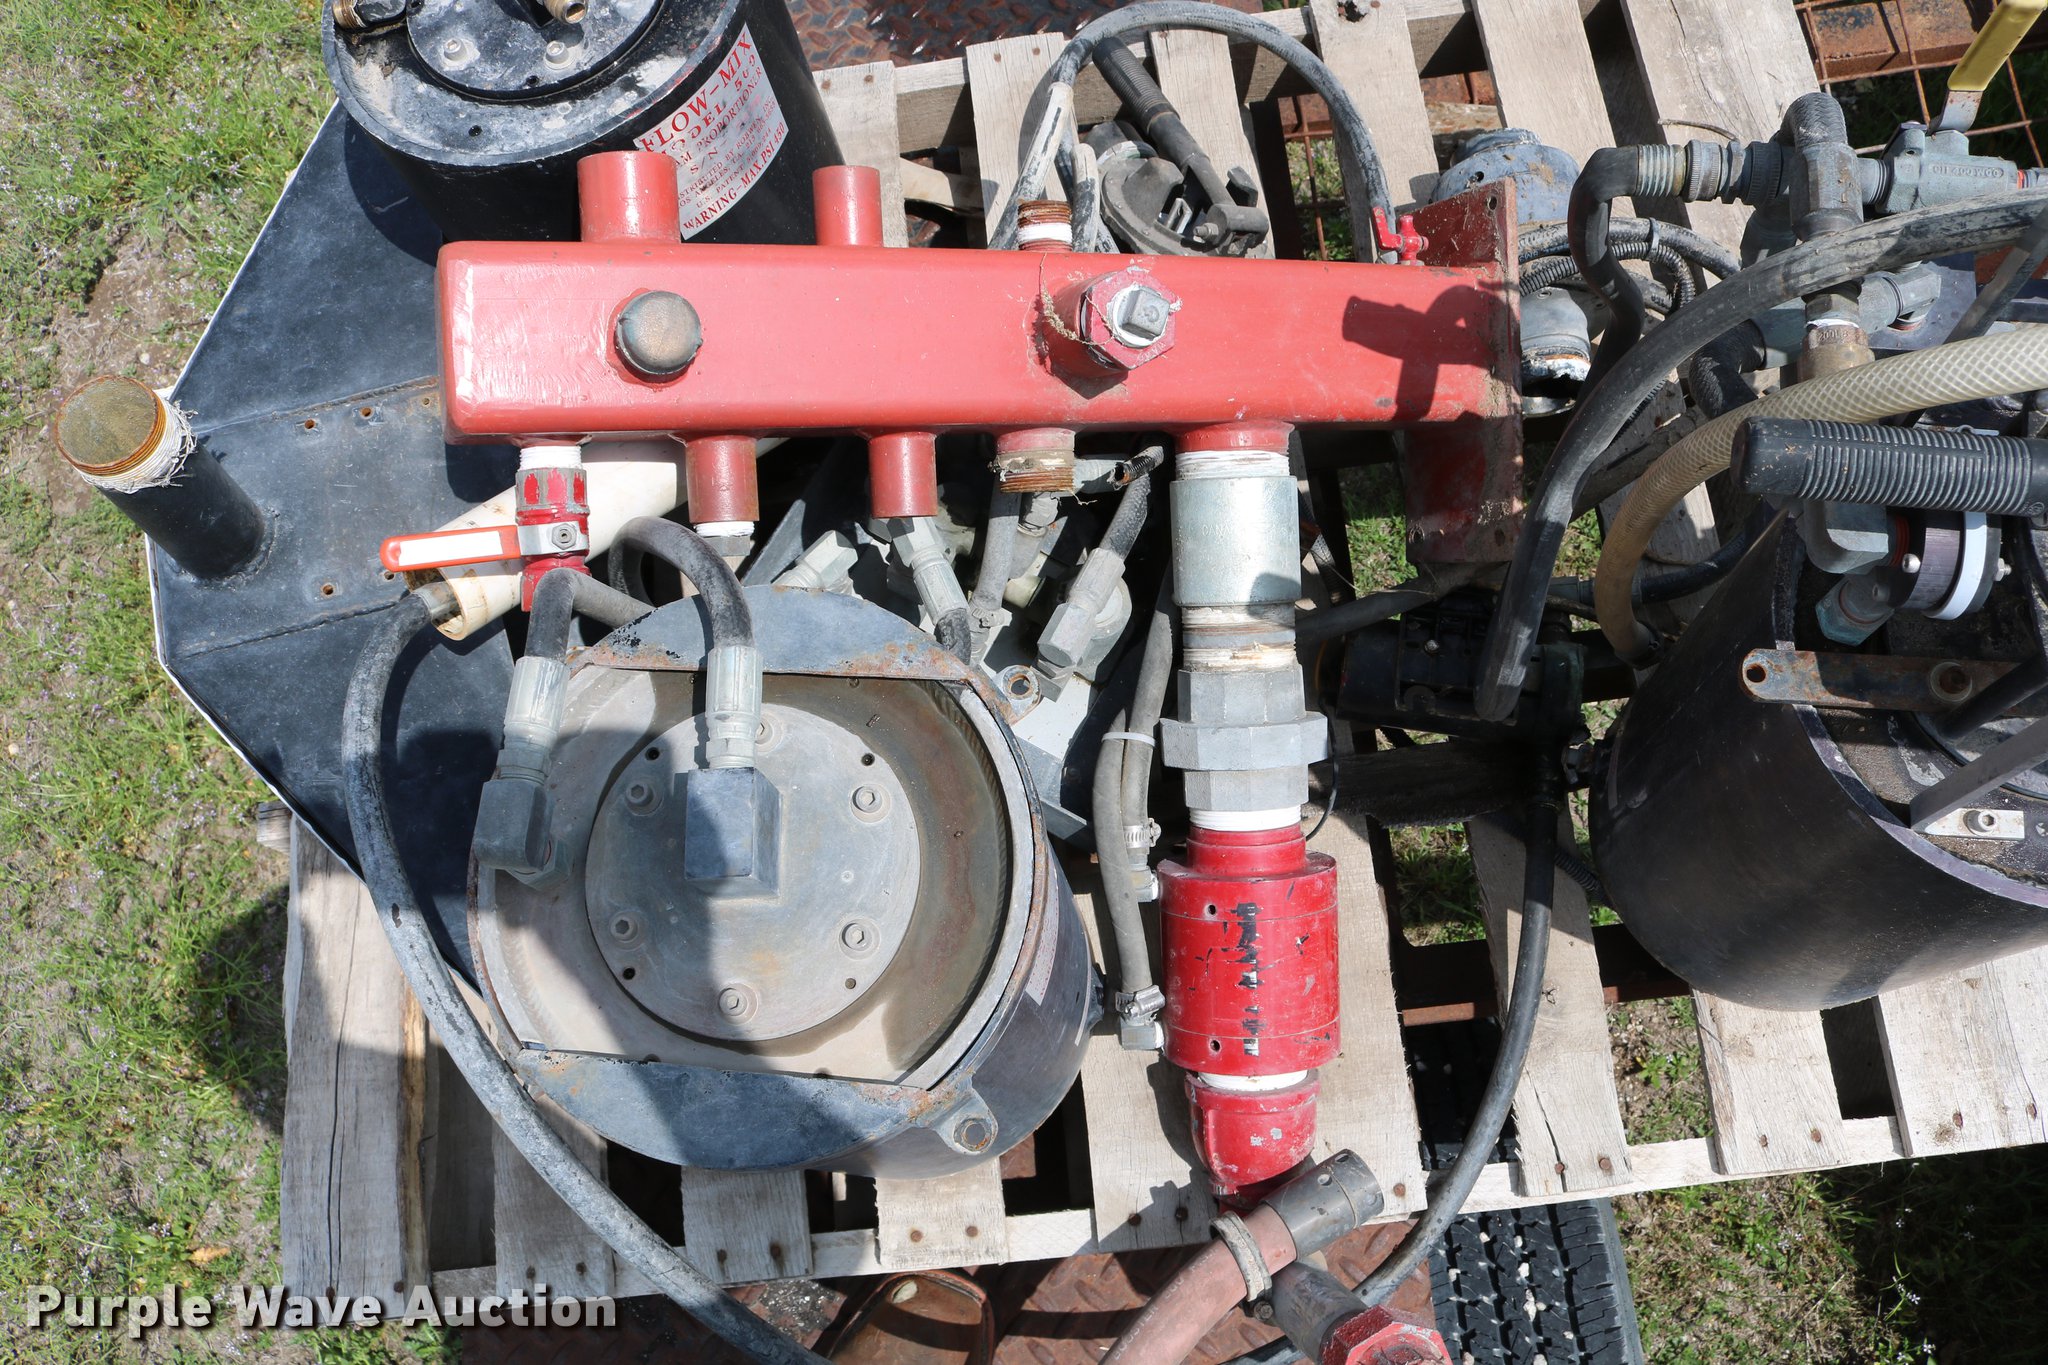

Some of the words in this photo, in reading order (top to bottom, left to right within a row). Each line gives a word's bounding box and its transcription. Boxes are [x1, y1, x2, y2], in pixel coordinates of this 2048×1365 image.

[641, 33, 753, 152] FLOW-MIX
[773, 122, 785, 144] 450
[716, 163, 744, 193] PATENT
